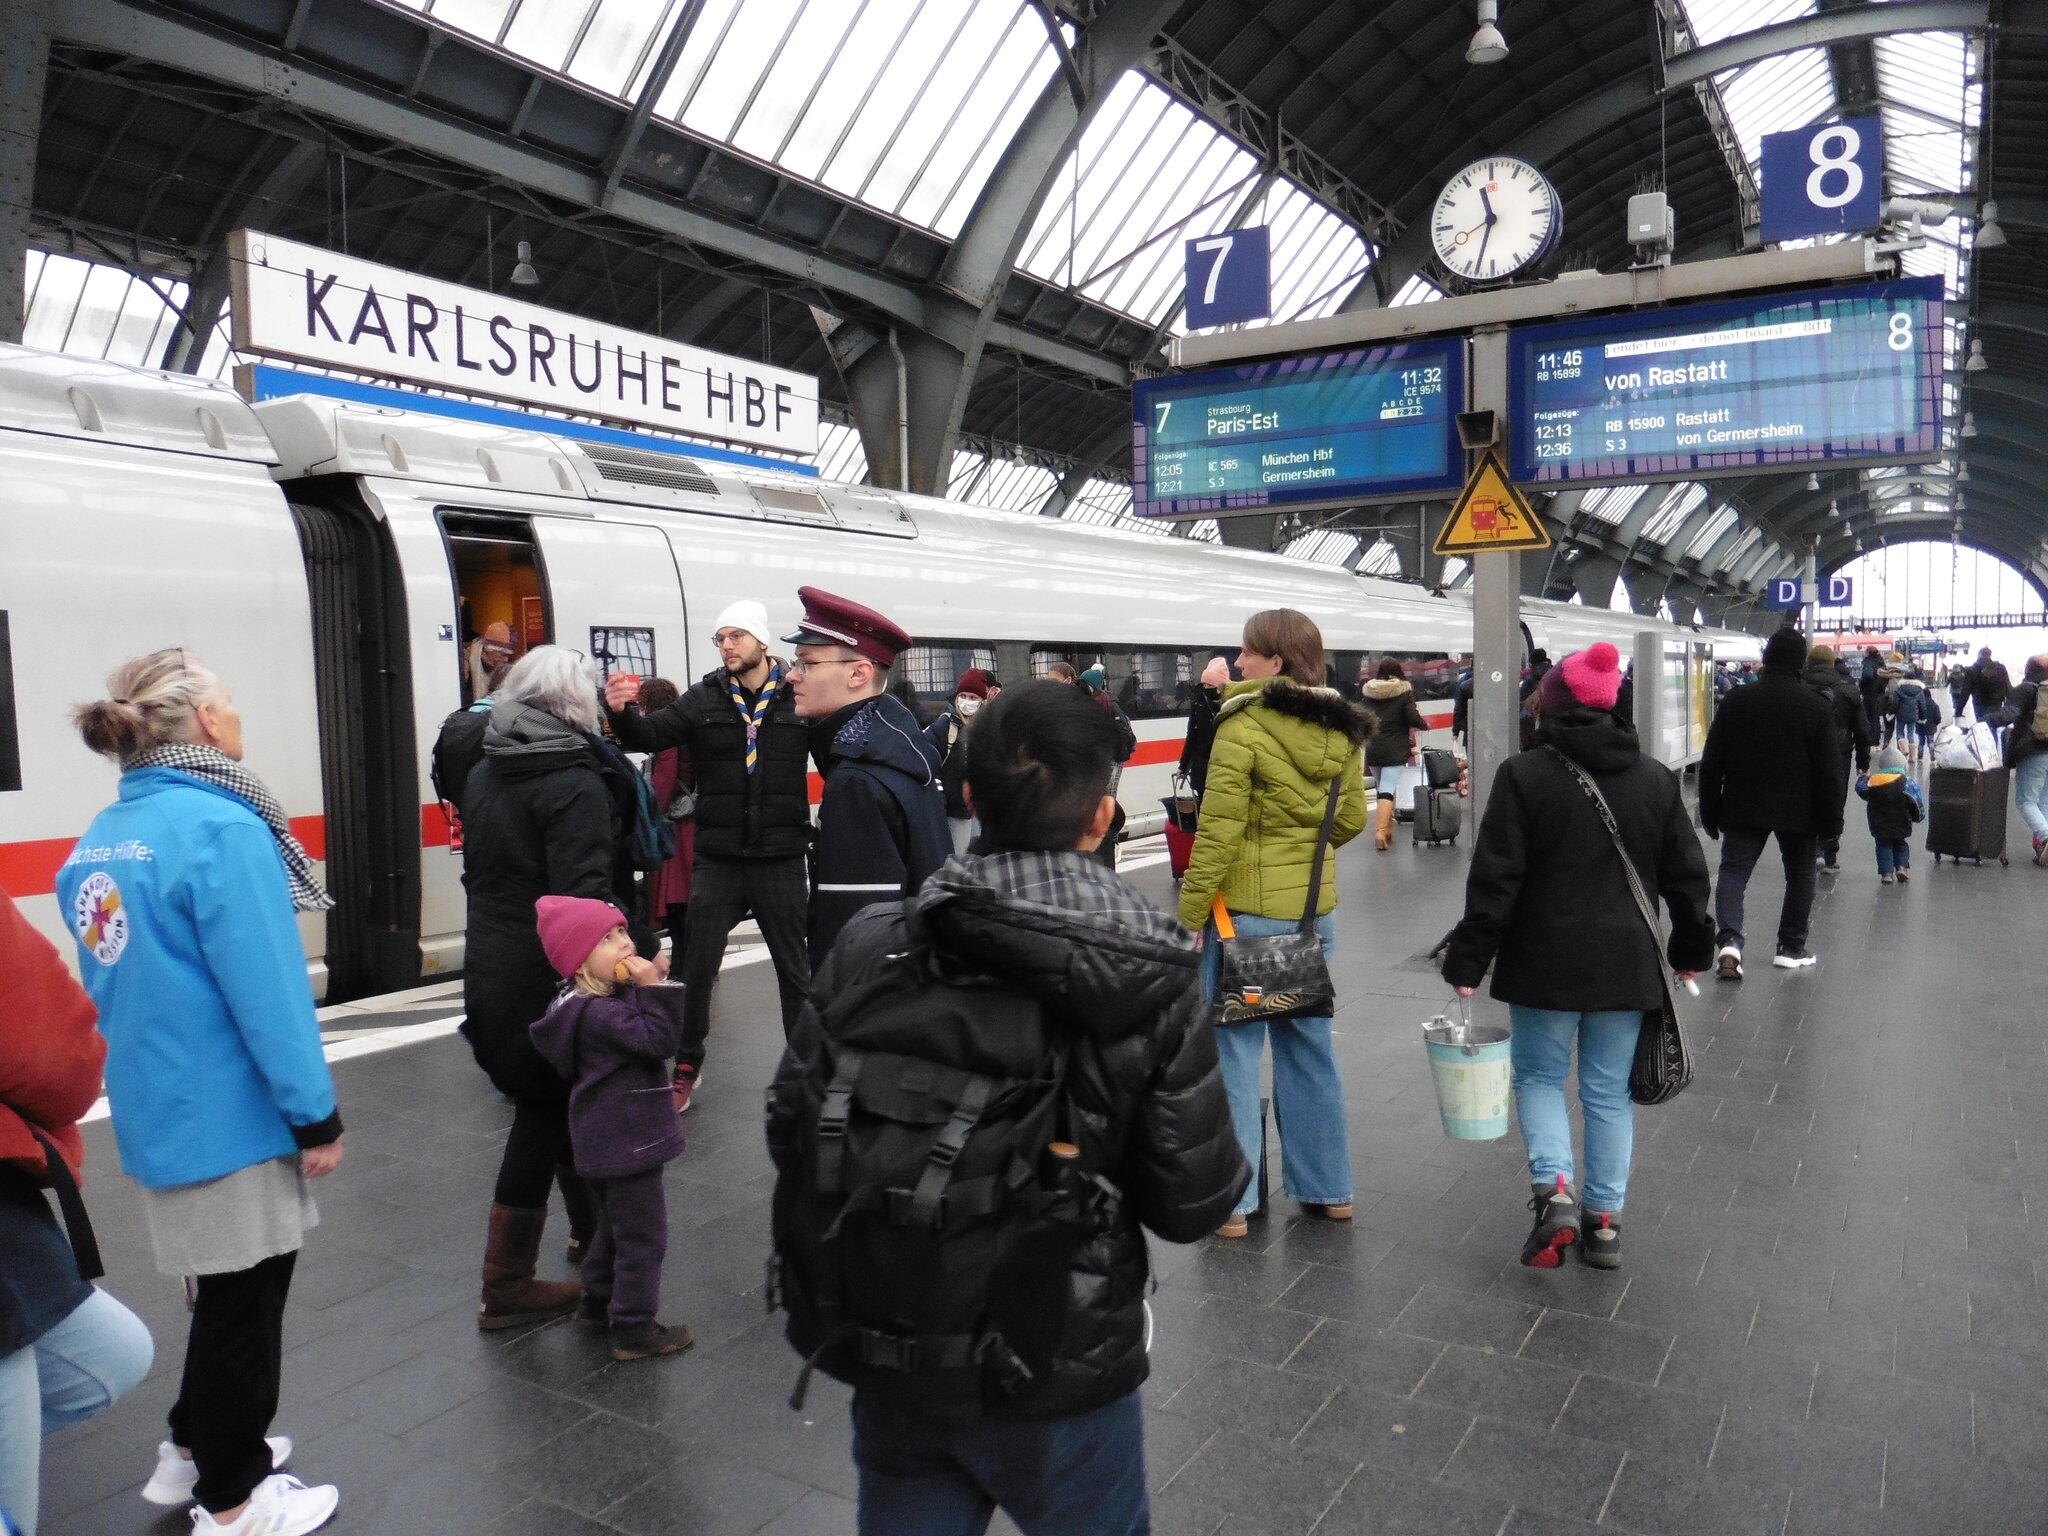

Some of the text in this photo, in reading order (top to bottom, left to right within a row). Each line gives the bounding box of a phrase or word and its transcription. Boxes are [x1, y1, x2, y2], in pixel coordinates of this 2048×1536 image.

[1806, 125, 1863, 208] 8
[1196, 236, 1233, 304] 7
[1745, 327, 1782, 338] board
[1803, 320, 1831, 332] Bitt
[1887, 312, 1913, 350] 8
[305, 268, 792, 433] KARLSRUHE HBF
[1538, 350, 1582, 369] 11:46
[1401, 367, 1441, 386] 11:32
[1537, 367, 1580, 381] RB 15899
[1604, 359, 1728, 391] von Rastatt
[1404, 383, 1441, 397] ICE 9574
[1207, 404, 1251, 417] Strasbourg
[1381, 401, 1388, 409] A
[1534, 410, 1579, 421] Folgezüge:
[1155, 402, 1172, 434] 7
[1207, 411, 1279, 436] Paris-Est
[1535, 408, 1730, 439] 12:13 RB 15900 Rastatt
[1535, 422, 1803, 457] 12:36 S 3 von Germersheim
[1155, 447, 1334, 477] 12:05 IC 565 München Hbf
[1155, 465, 1335, 493] 12:21 S 3 Germersheim
[1778, 581, 1796, 603] D
[1829, 578, 1848, 601] D
